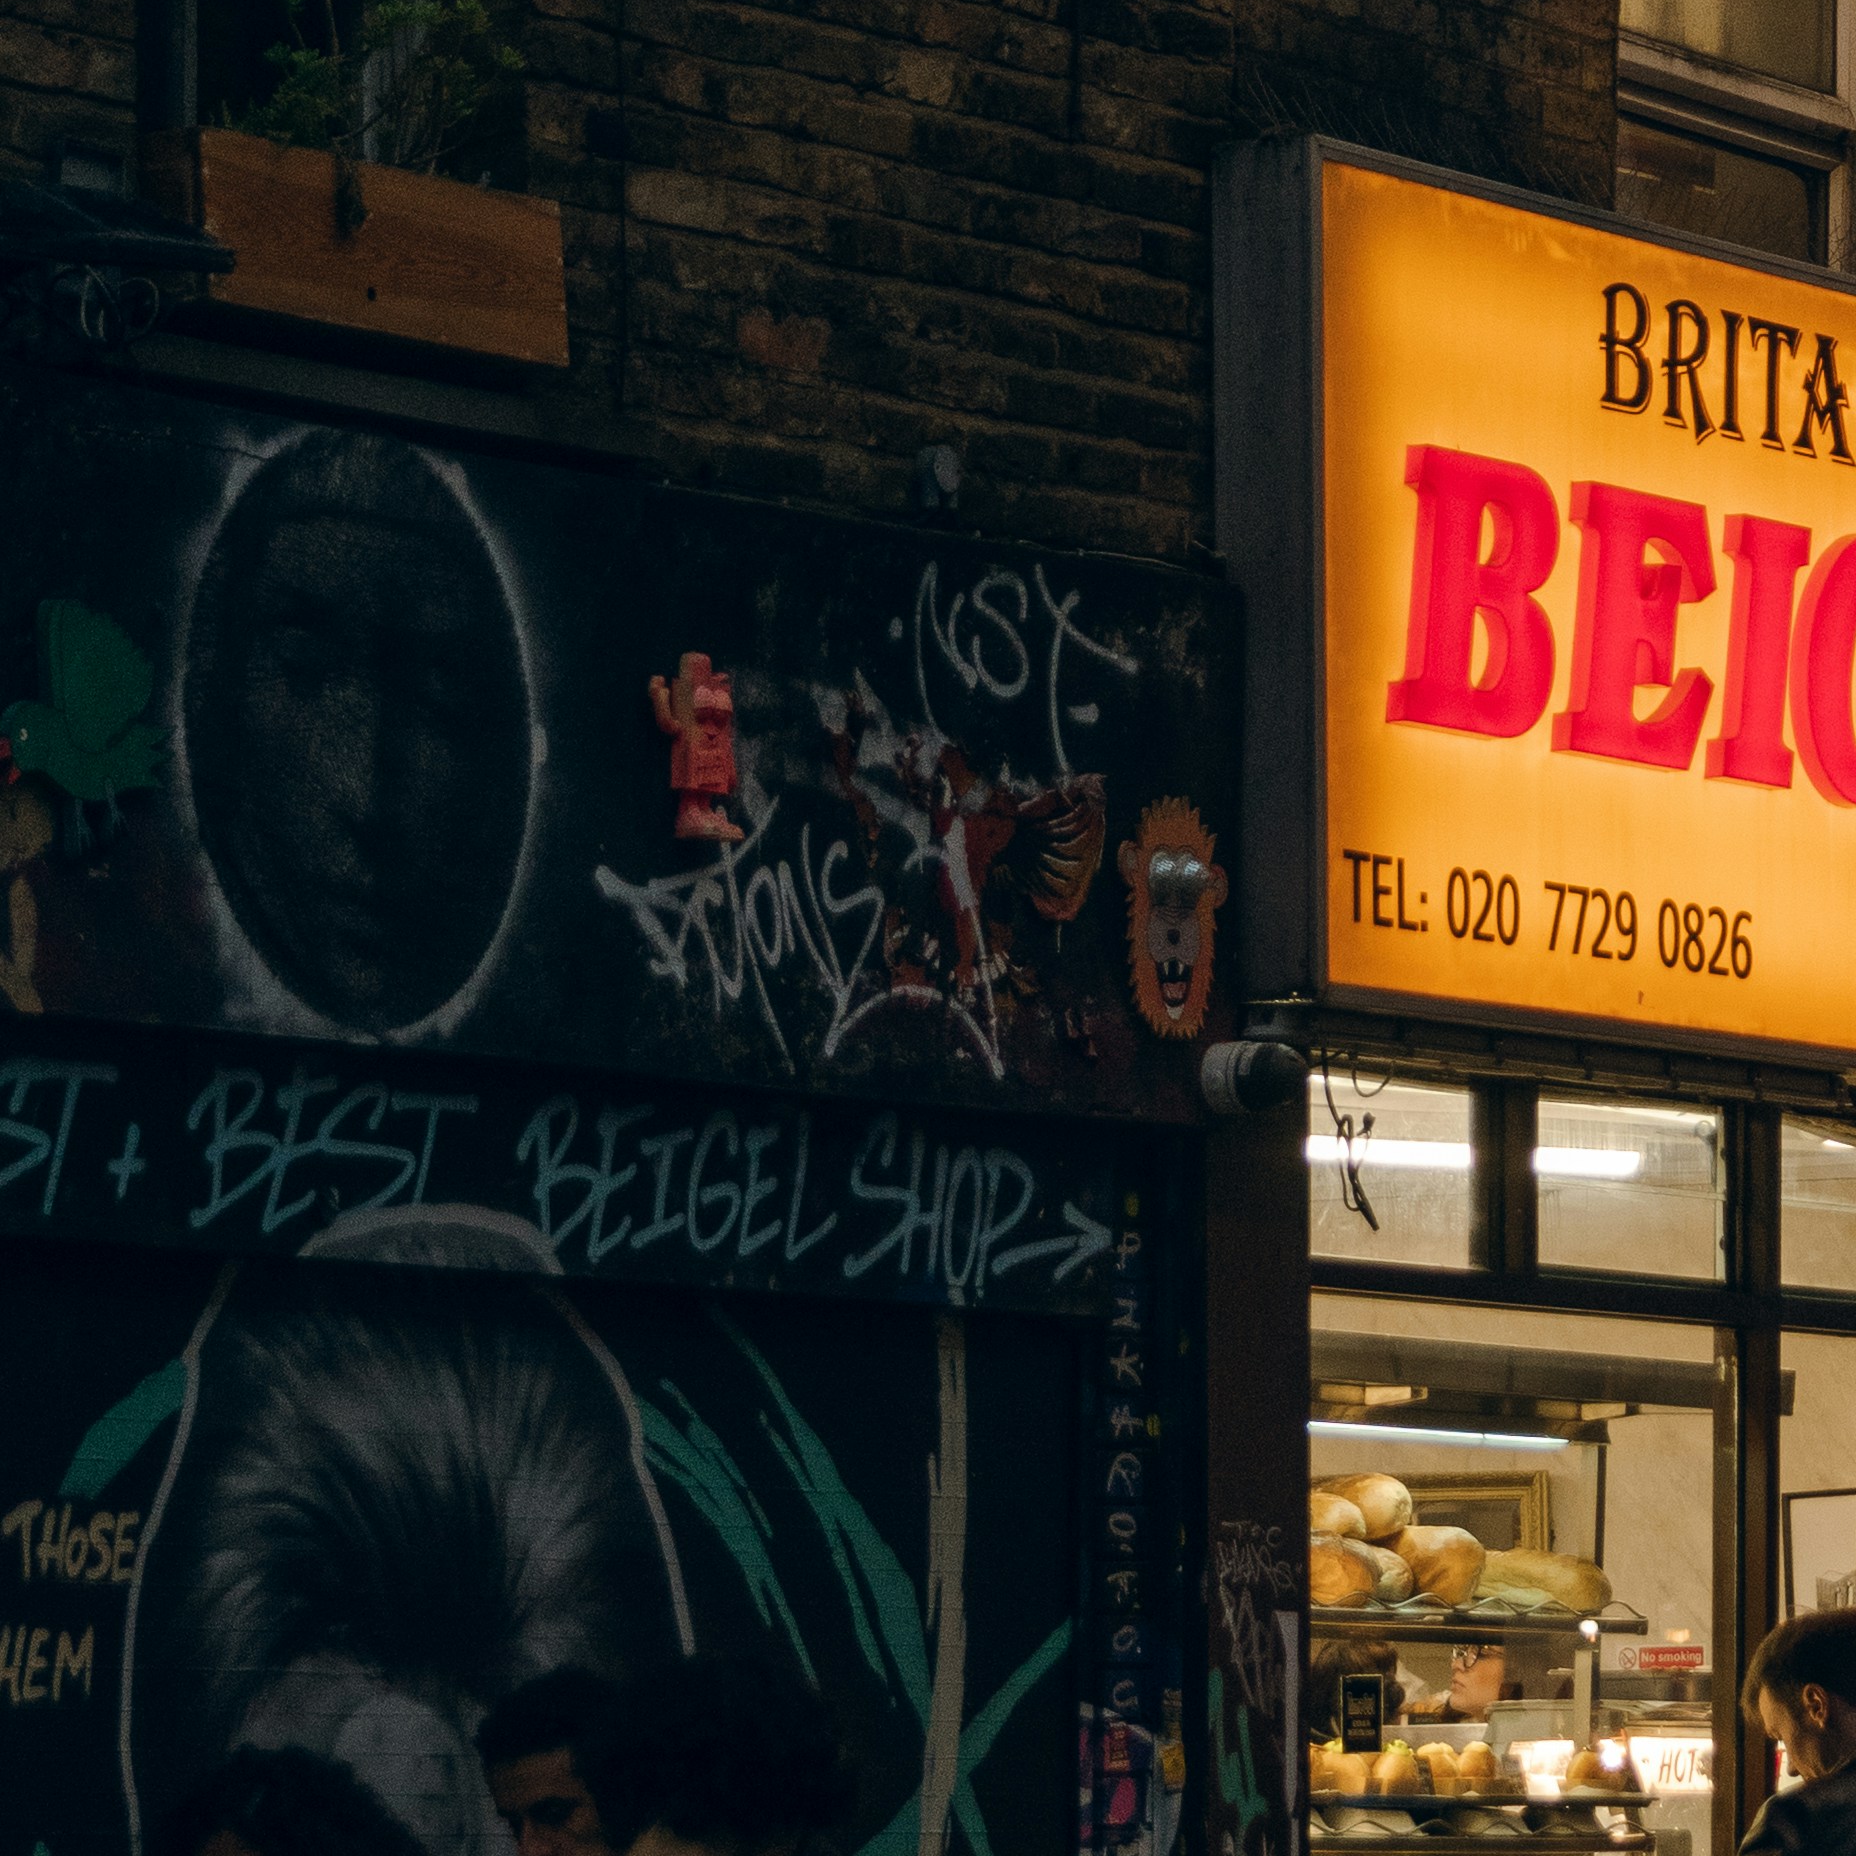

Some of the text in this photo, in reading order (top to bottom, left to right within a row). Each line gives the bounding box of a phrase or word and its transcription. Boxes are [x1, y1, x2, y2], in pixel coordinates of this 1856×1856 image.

[1343, 849, 1753, 983] TEL: 020 7729 0826
[188, 1064, 479, 1235] BEST
[516, 1091, 839, 1267] BEIGEL
[843, 1110, 1036, 1296] SHOP
[1, 1497, 140, 1586] THOSE
[1640, 1650, 1702, 1664] No smoking
[1658, 1747, 1698, 1784] HOT
